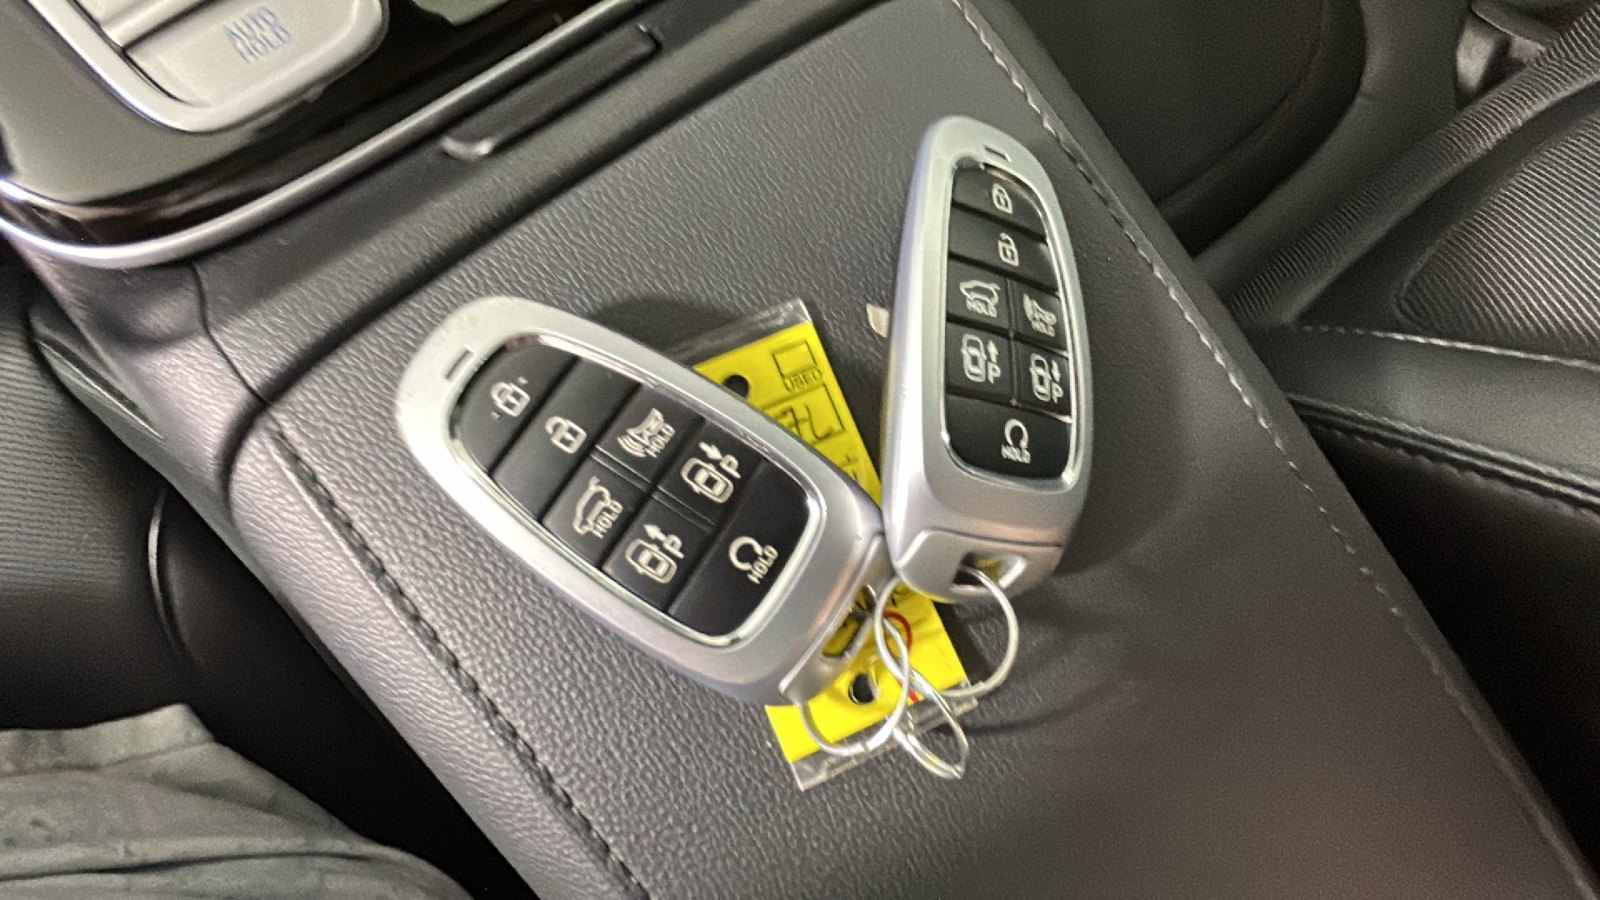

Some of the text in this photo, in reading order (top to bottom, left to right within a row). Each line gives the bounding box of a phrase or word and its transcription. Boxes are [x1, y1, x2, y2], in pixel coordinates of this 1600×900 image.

[224, 5, 277, 43] AUTO
[236, 25, 291, 65] HOLD
[987, 361, 1001, 384] P
[1051, 381, 1064, 404] P
[644, 422, 676, 458] HOLD
[719, 454, 741, 479] P
[591, 500, 623, 539] HOLD
[662, 534, 685, 559] P
[746, 545, 778, 584] HOLD
